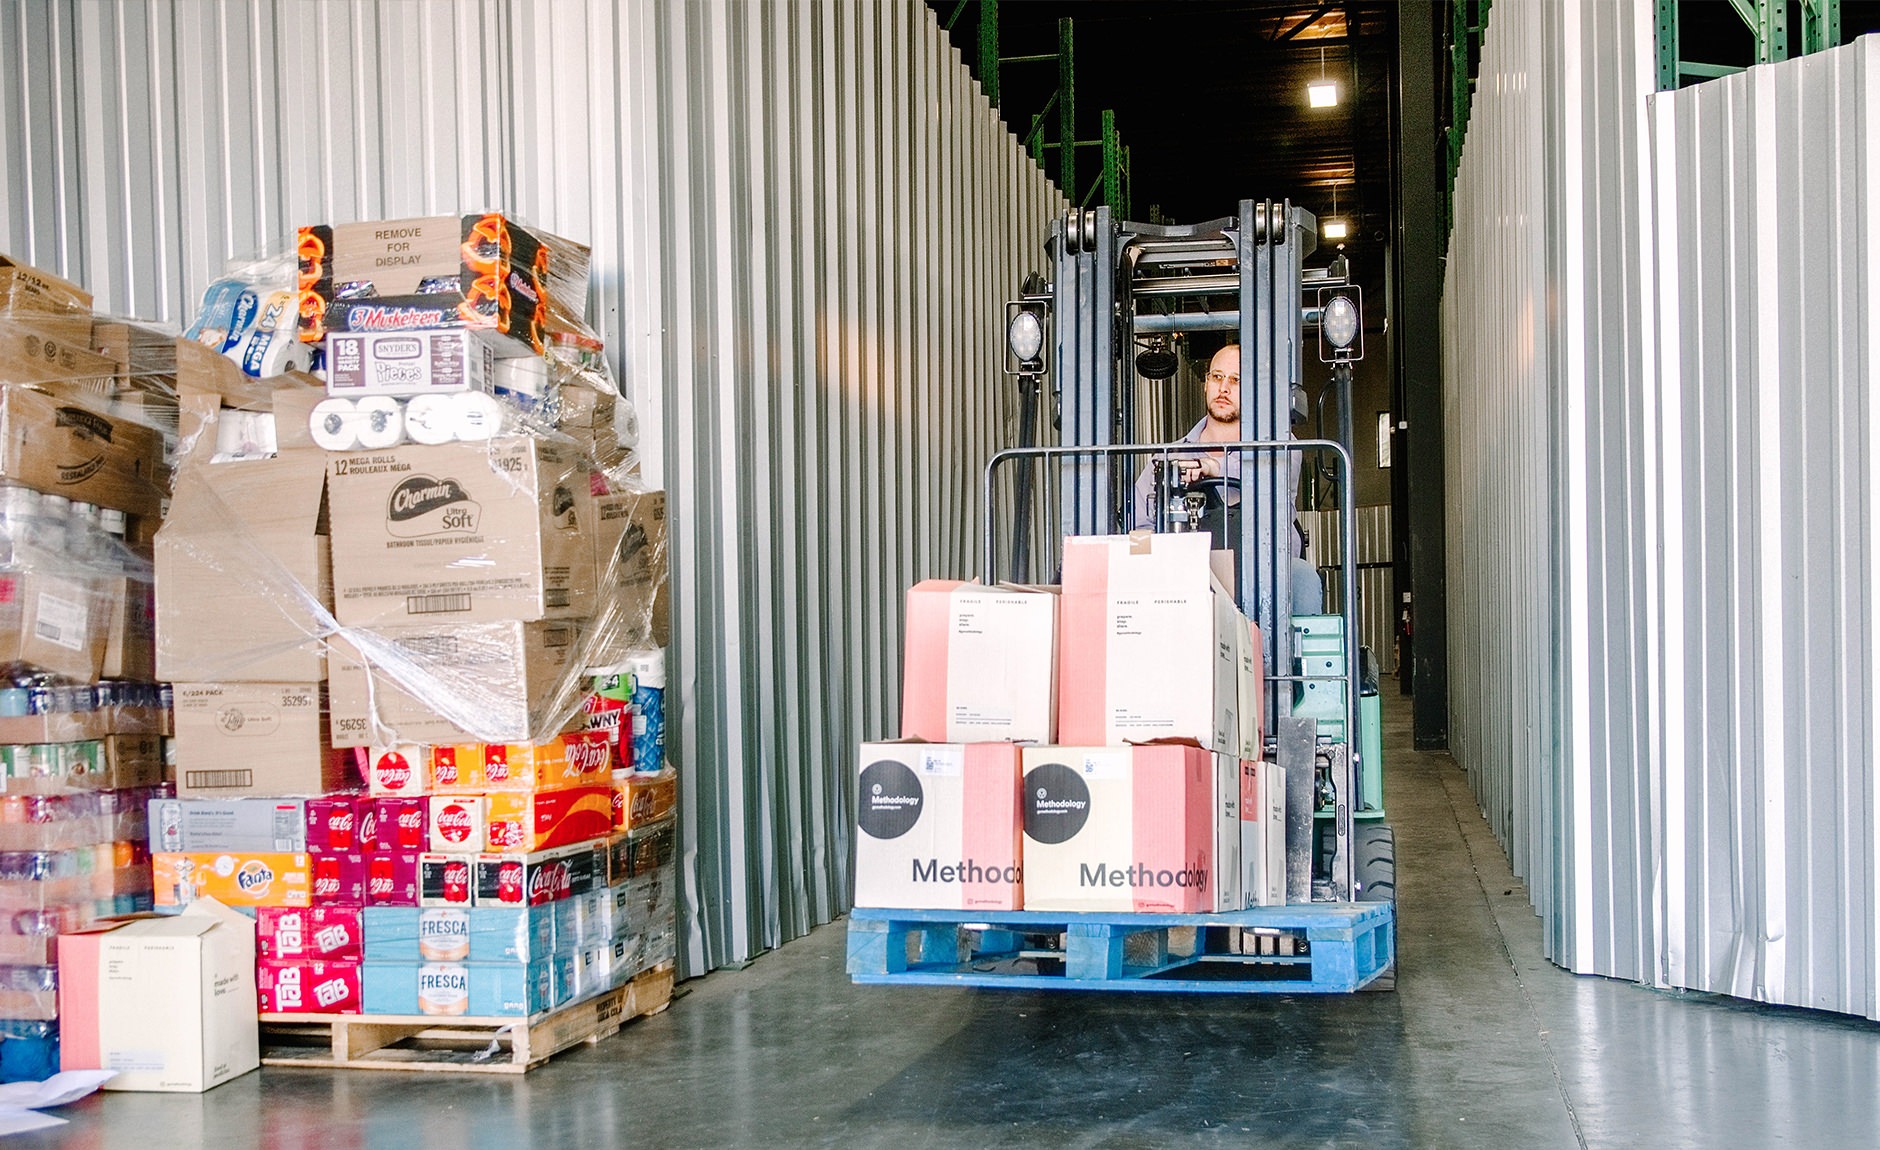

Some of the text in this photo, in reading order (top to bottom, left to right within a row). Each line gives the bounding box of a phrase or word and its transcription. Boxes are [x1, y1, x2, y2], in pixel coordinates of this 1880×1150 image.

[375, 227, 422, 240] REMOVE
[387, 242, 410, 252] FOR
[375, 254, 422, 267] DISPLAY
[229, 293, 254, 342] Charmin
[261, 303, 283, 329] 24
[351, 307, 442, 329] 3 Musketeers
[250, 334, 271, 371] MEGA
[336, 339, 359, 356] 18
[378, 343, 417, 353] SNYDER'S
[338, 363, 360, 372] PACK
[375, 361, 422, 383] Pieces
[335, 459, 348, 476] 12
[349, 455, 396, 466] MEGA ROLLS
[349, 464, 388, 475] ROULEAUX
[394, 479, 452, 513] Charmin
[446, 508, 468, 516] Ultra
[442, 514, 473, 530] Soft
[282, 695, 308, 707] 35295
[340, 718, 367, 731] 35295
[871, 795, 920, 806] Methodology
[1036, 799, 1086, 809] Methodology
[238, 868, 273, 890] Fanta
[528, 858, 574, 898] Coca-Cola
[1079, 862, 1208, 893] Methodology
[314, 908, 325, 917] 12
[422, 920, 467, 937] FRESCA
[314, 962, 325, 972] 12
[421, 974, 466, 991] FRESCA
